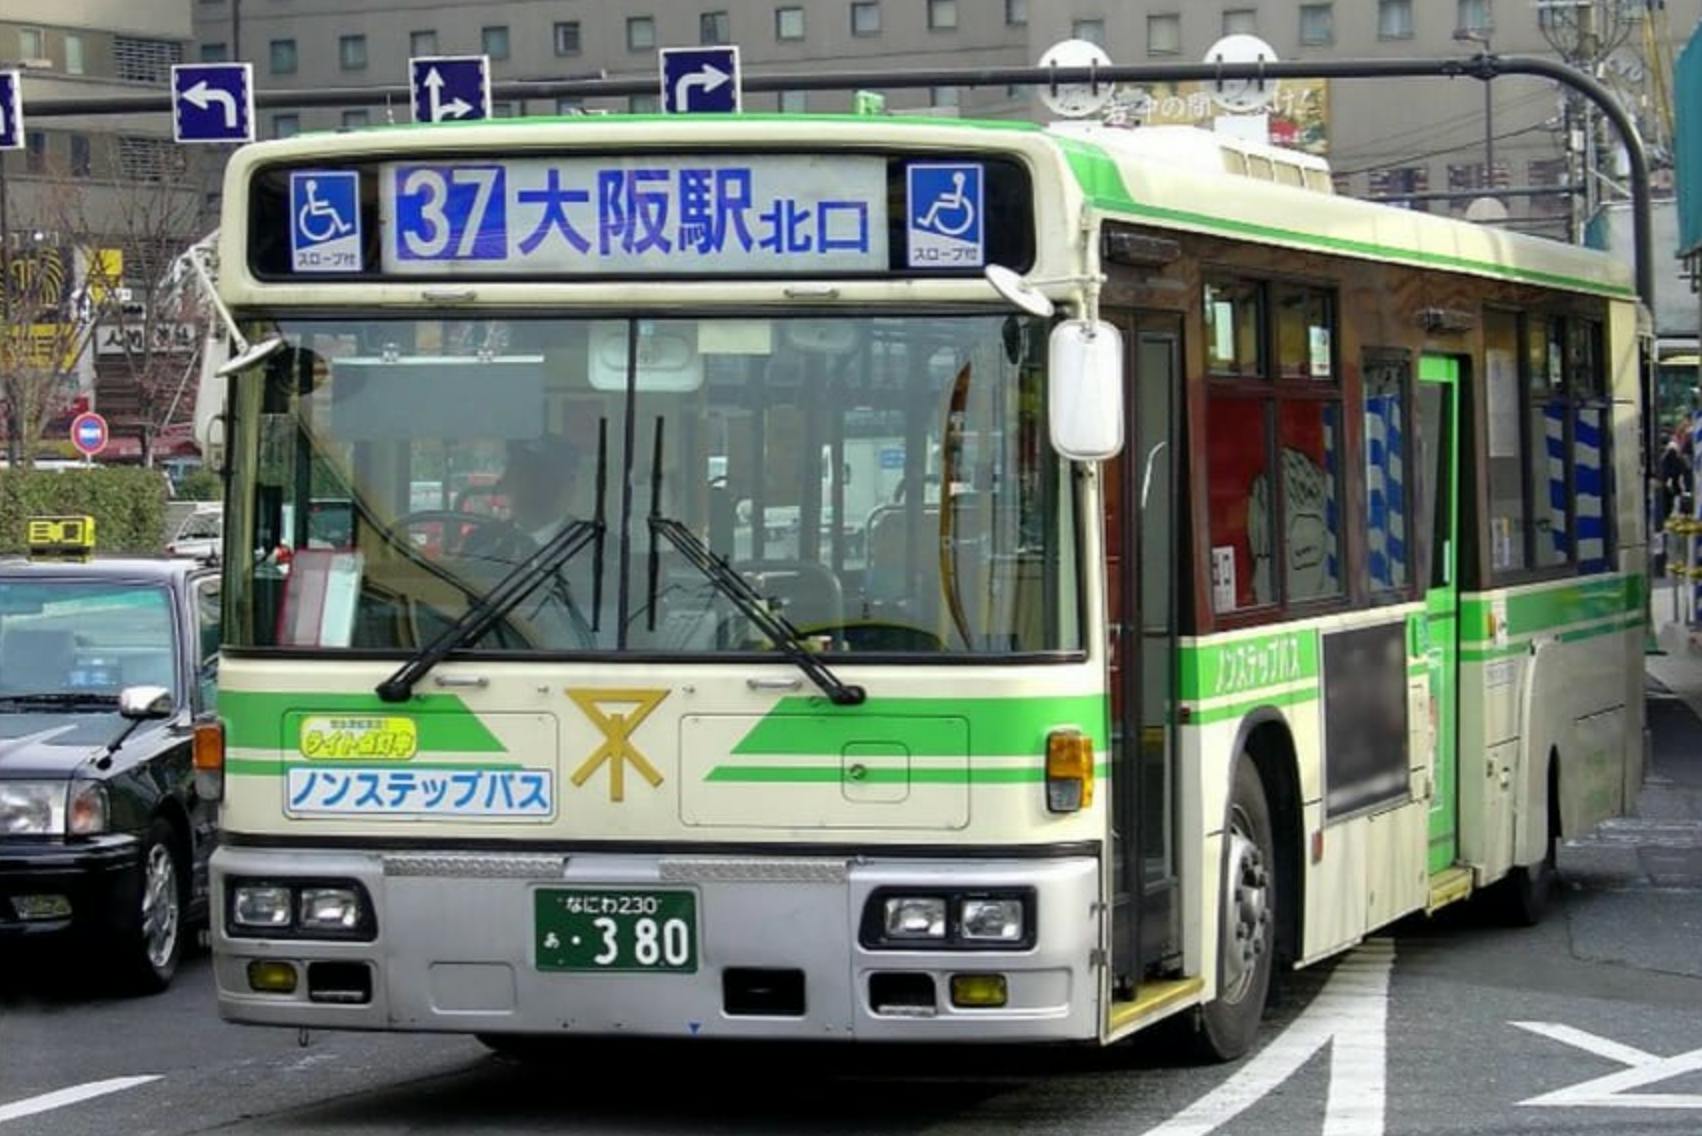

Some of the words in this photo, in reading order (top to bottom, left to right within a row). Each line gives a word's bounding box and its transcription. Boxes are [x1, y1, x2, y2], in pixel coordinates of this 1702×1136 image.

[403, 168, 498, 257] 37
[298, 252, 355, 267] スロープ付
[913, 246, 978, 261] スロープ付
[292, 770, 548, 809] ノンステップバス
